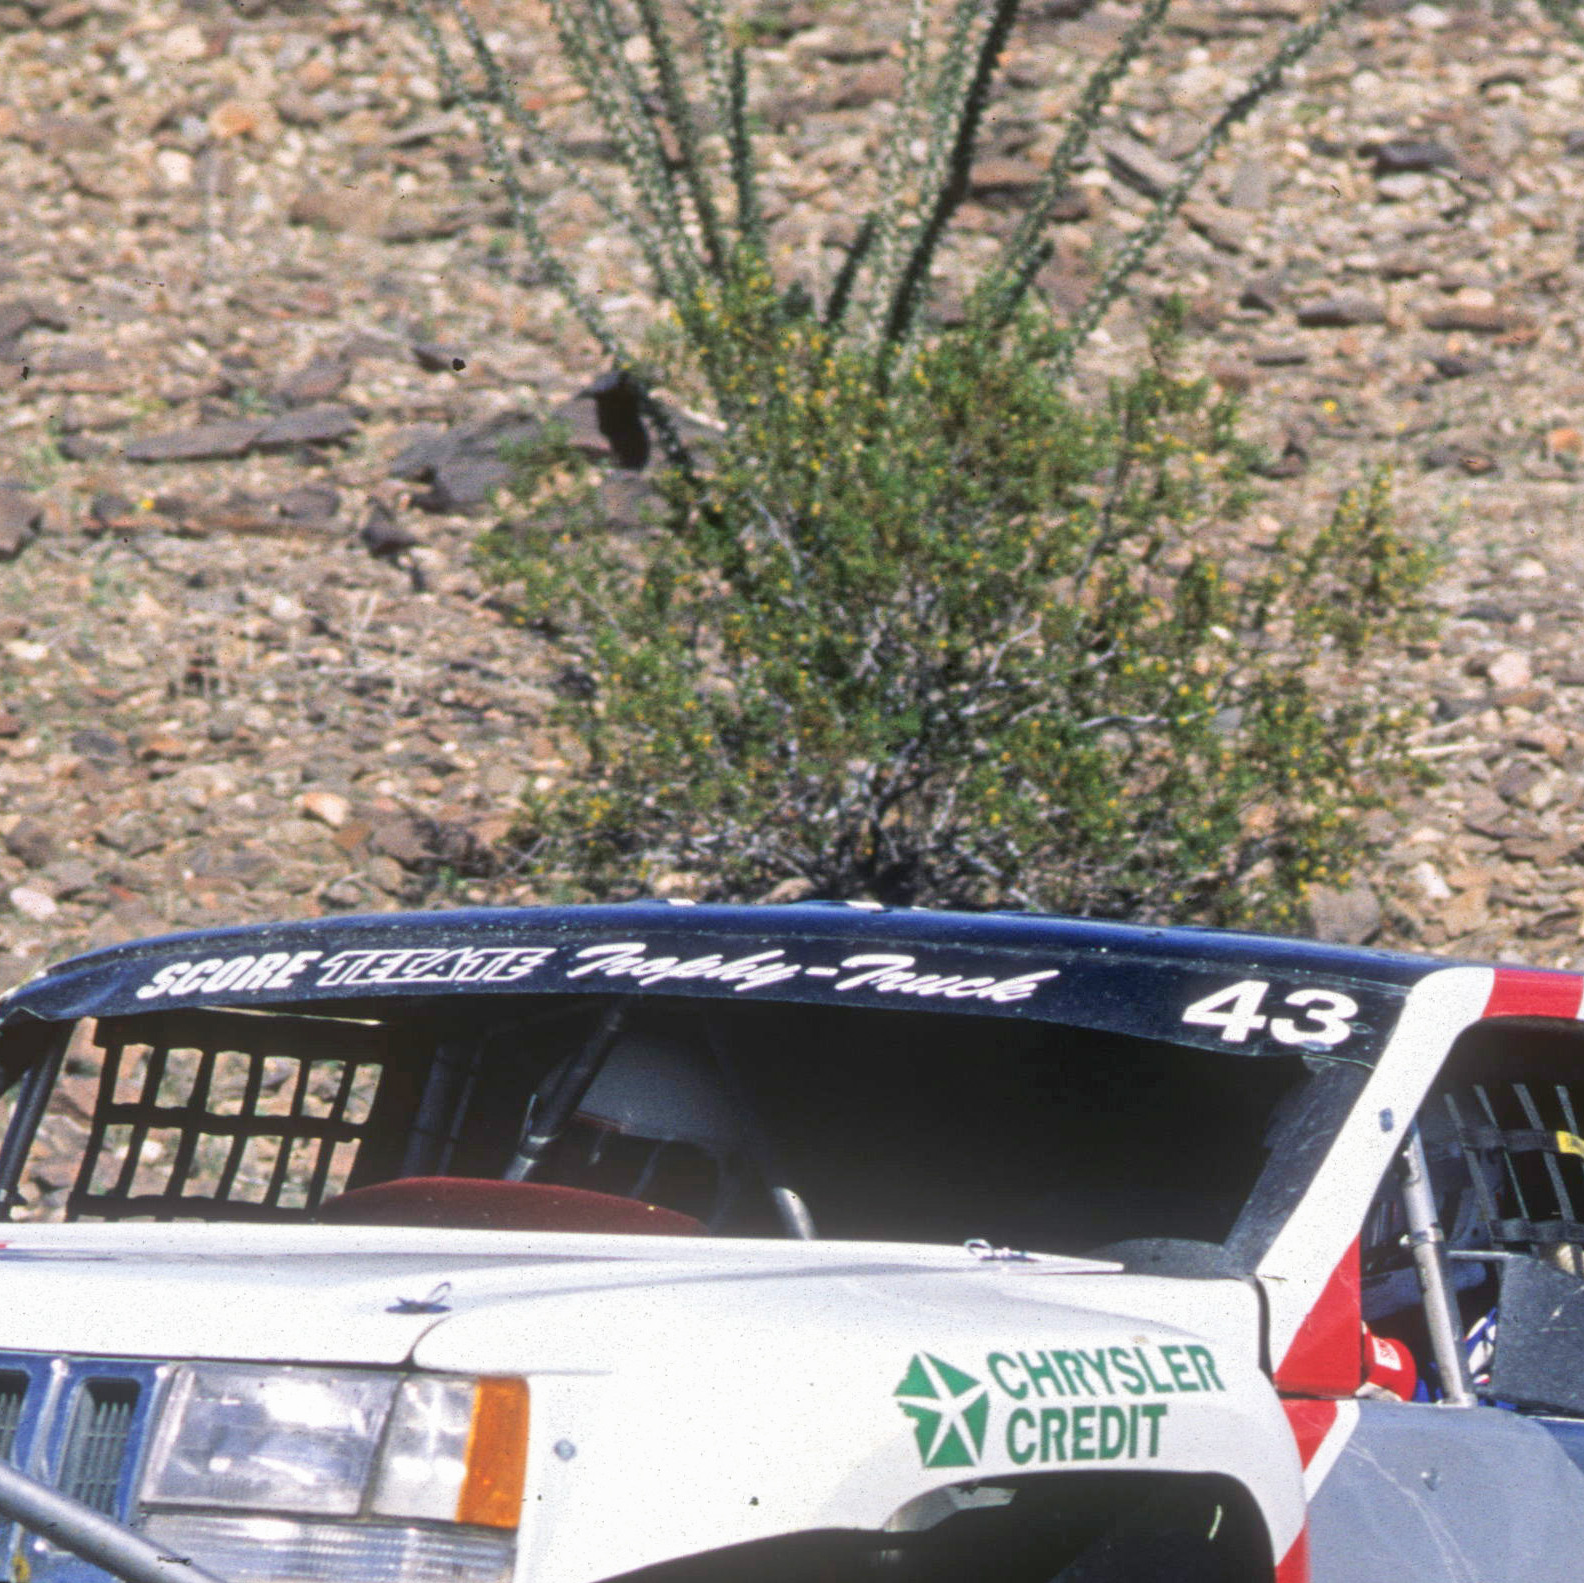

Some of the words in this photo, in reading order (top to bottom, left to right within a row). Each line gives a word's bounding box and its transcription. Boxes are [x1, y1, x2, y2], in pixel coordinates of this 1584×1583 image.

[137, 950, 324, 999] SCORE
[317, 947, 556, 987] TECATE
[1181, 980, 1360, 1046] 43
[986, 1344, 1226, 1401] CHRYSLER
[1005, 1403, 1168, 1467] CREDIT
